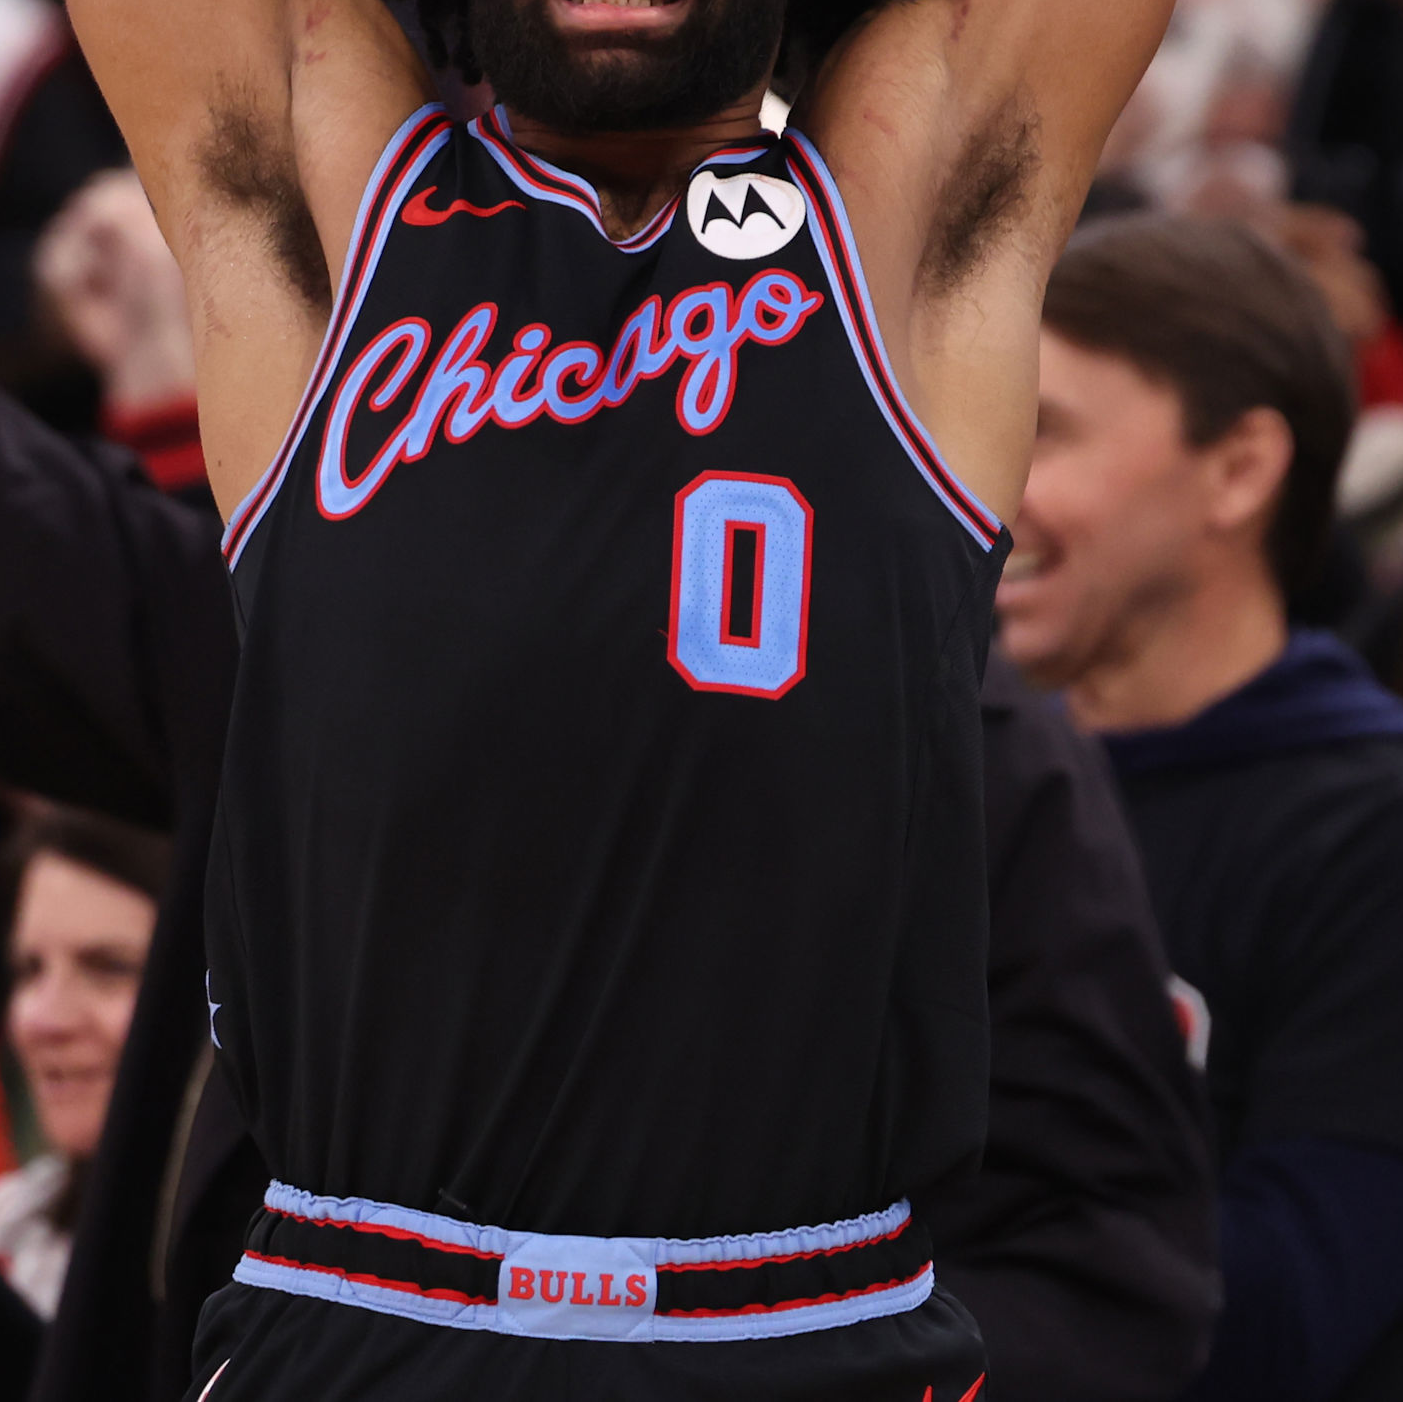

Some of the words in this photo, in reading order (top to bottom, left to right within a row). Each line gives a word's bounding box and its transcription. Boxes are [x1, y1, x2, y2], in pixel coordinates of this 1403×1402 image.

[316, 269, 823, 520] Chicago
[667, 470, 814, 701] 0
[507, 1267, 647, 1308] BULLS
